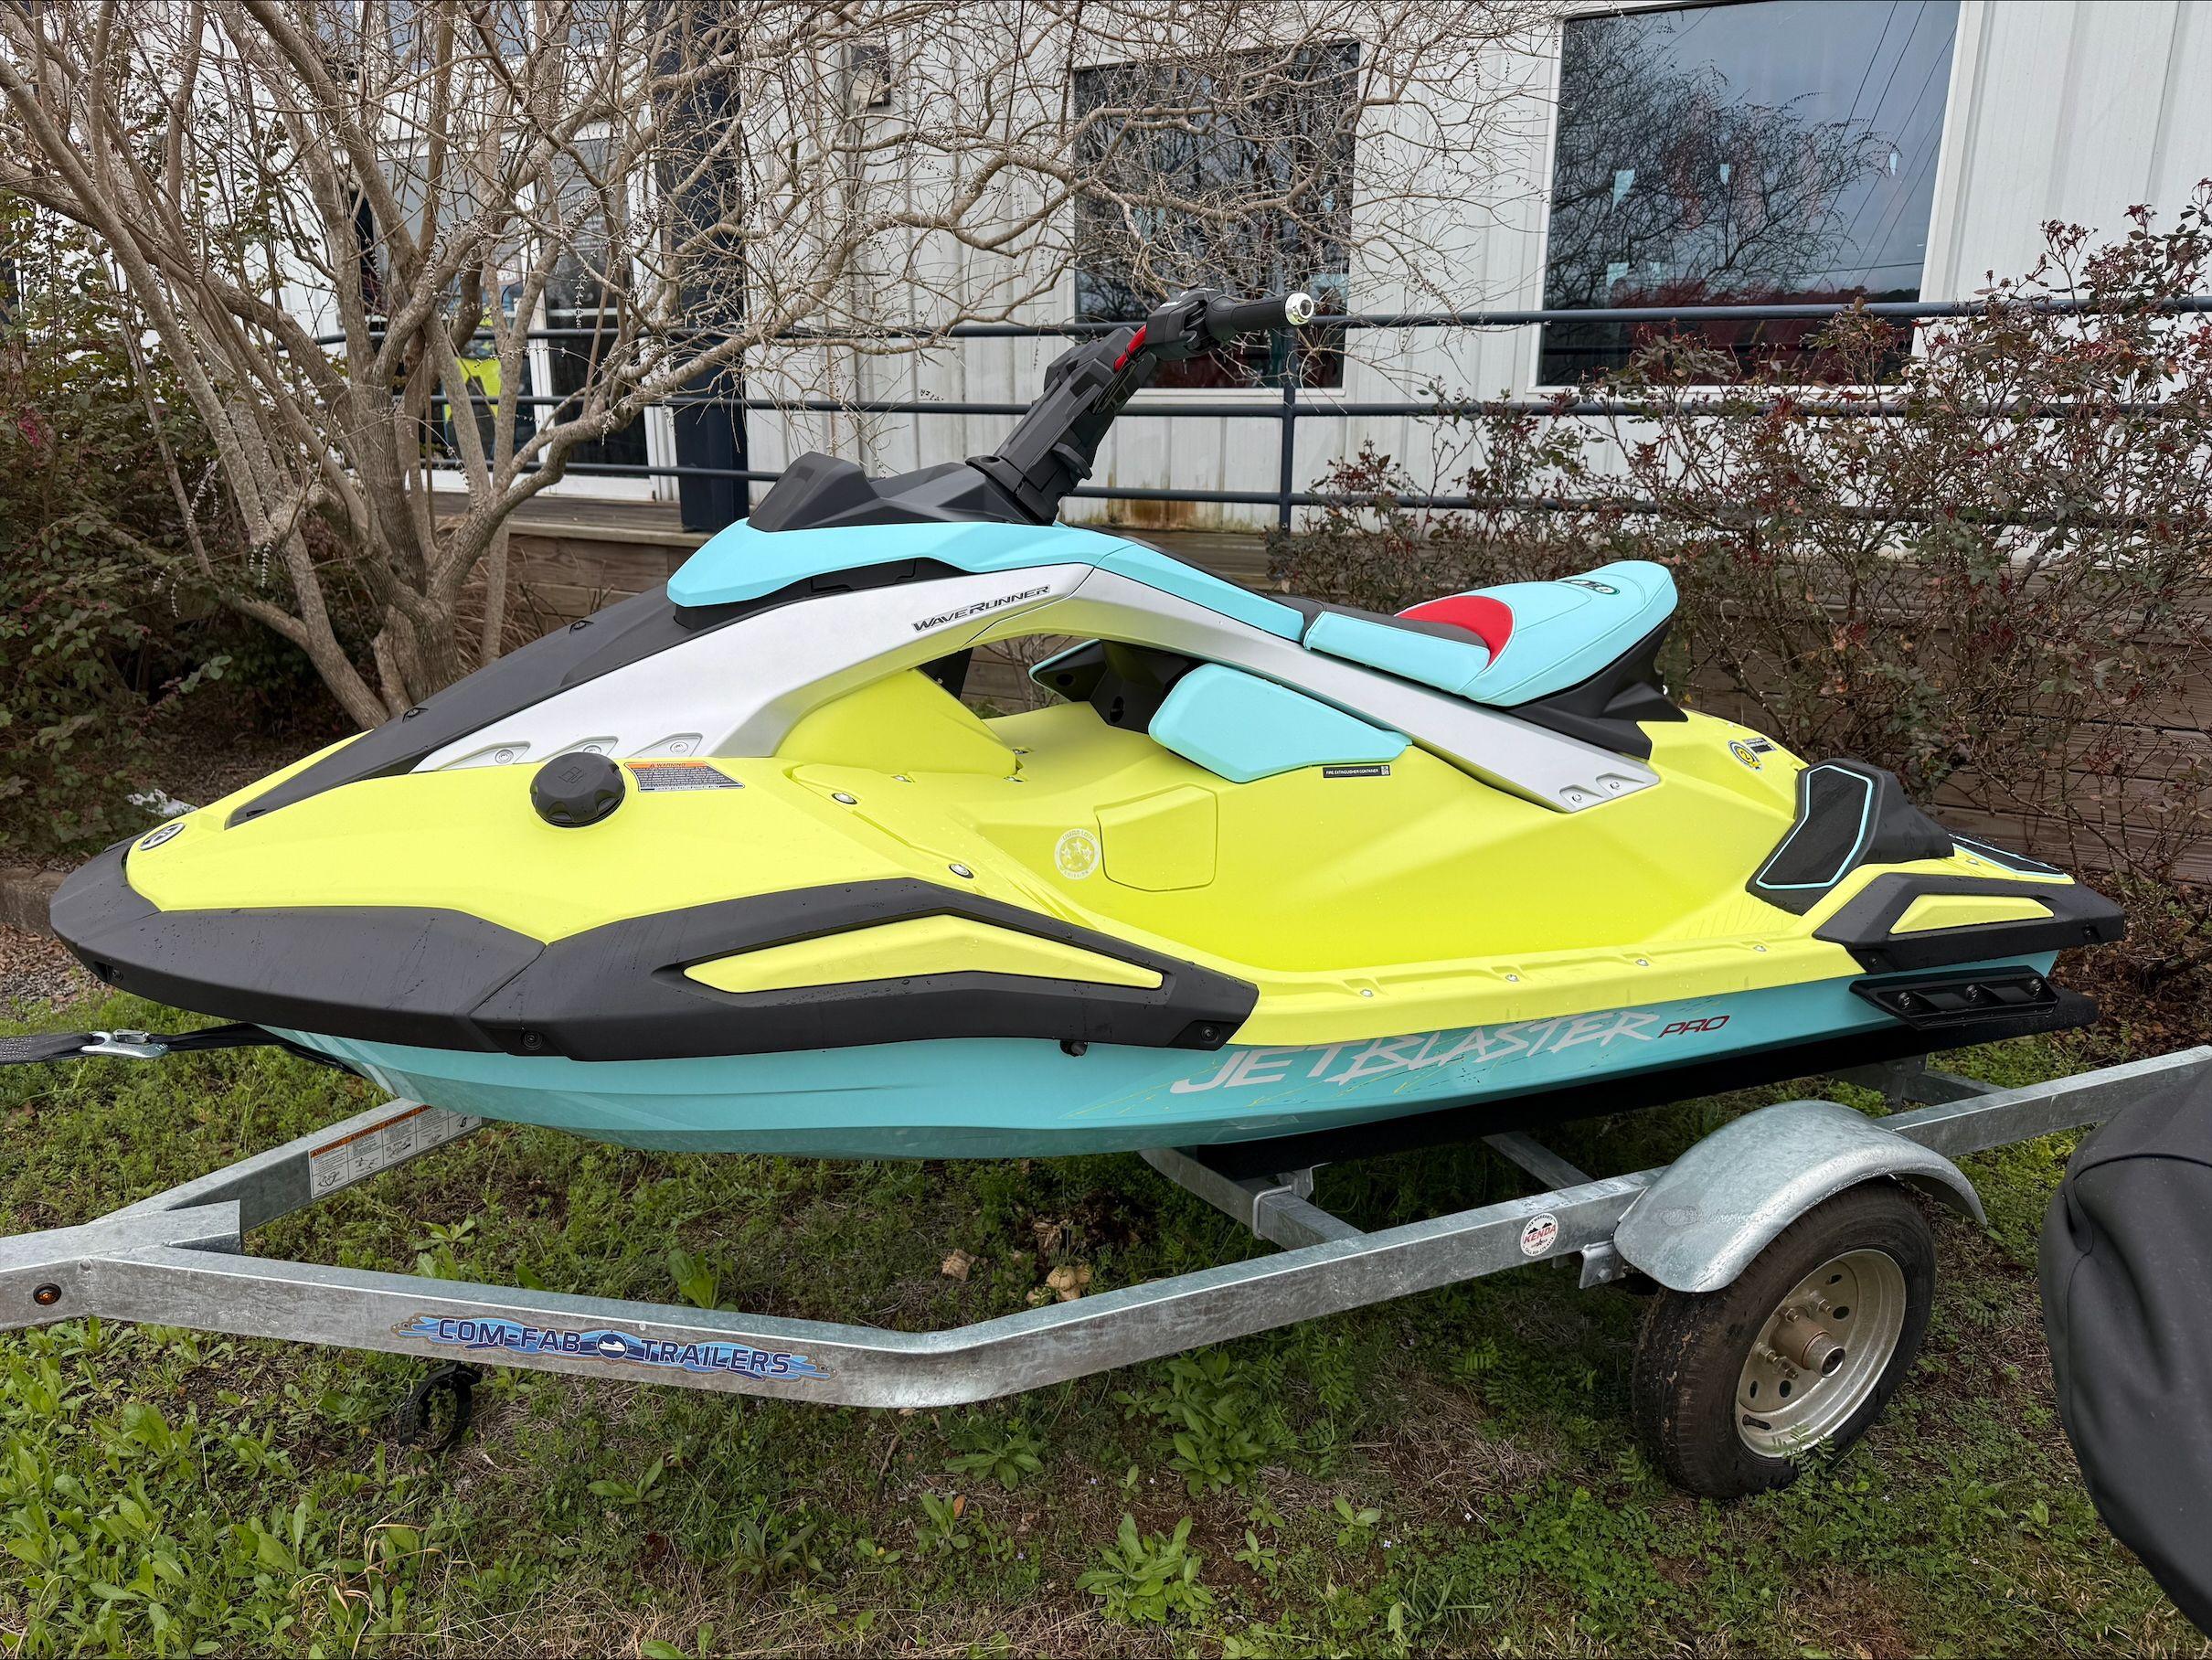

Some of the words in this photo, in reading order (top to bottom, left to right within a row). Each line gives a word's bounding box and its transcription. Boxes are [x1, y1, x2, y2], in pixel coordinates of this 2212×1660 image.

[913, 585, 1050, 632] WAVERUNNER
[1657, 1015, 1730, 1038] PRO
[1523, 1225, 1557, 1244] KENDA
[437, 1318, 582, 1354] COM-FAB
[640, 1338, 792, 1374] TRAILERS
